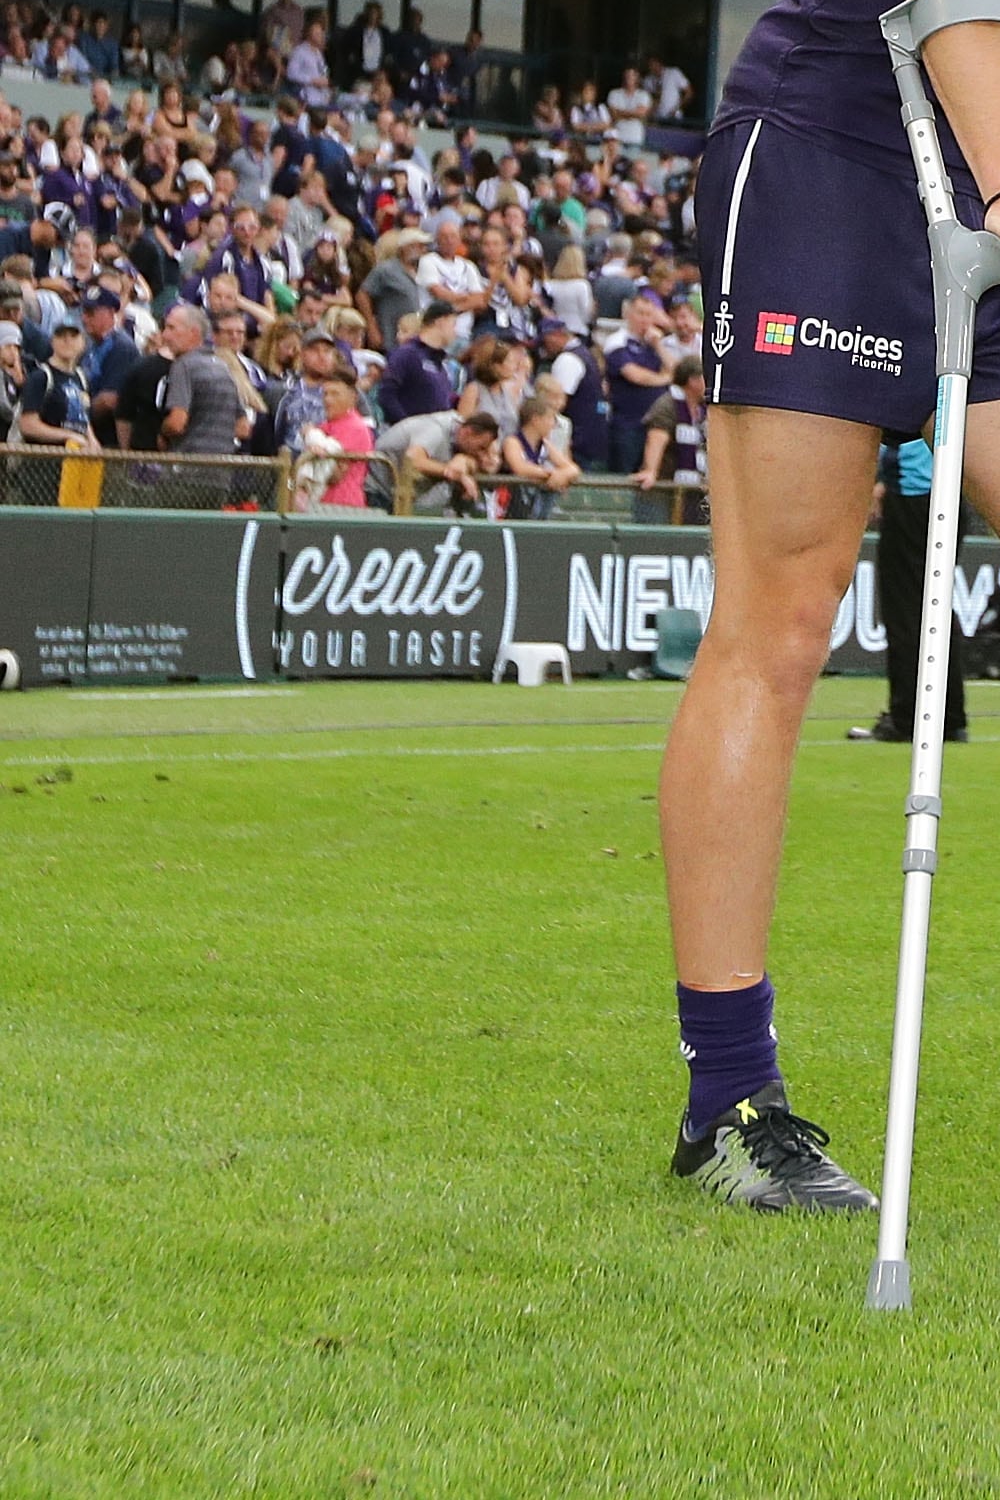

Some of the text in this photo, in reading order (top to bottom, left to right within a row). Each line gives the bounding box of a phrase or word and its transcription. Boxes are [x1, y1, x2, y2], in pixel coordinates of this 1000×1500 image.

[799, 316, 904, 361] Choices
[850, 354, 902, 377] Flooring
[274, 525, 485, 616] create
[272, 629, 484, 668] YOUR TASTE
